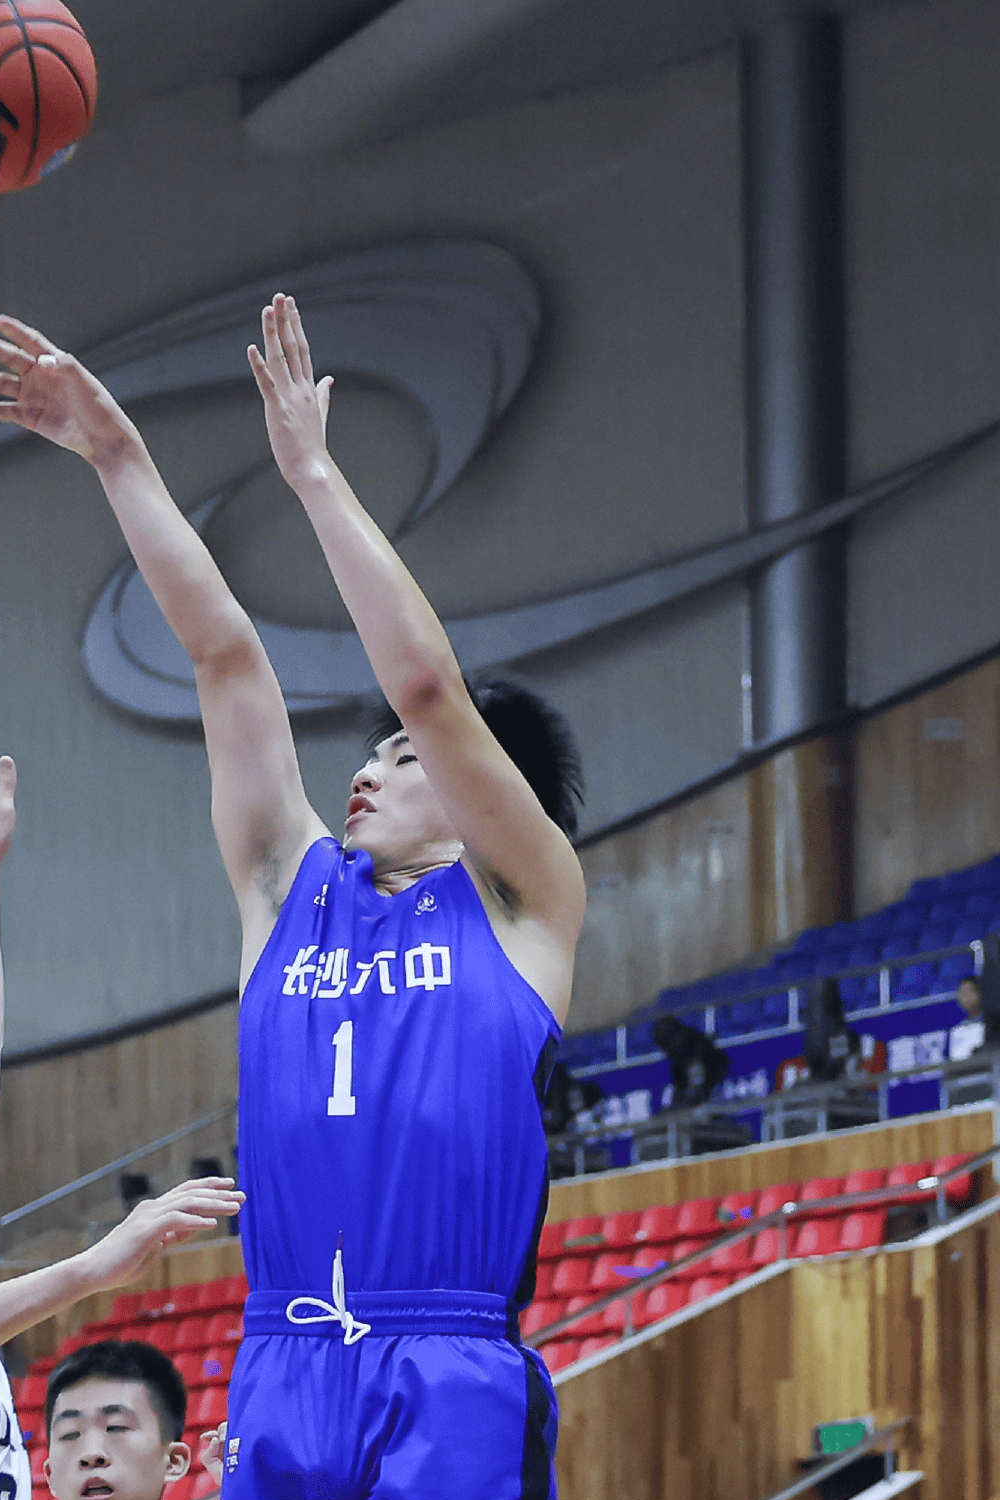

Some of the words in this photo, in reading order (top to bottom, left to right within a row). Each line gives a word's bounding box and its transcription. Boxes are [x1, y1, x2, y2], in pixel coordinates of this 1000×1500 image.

[282, 942, 452, 999] 长沙六中
[327, 1020, 356, 1116] 1
